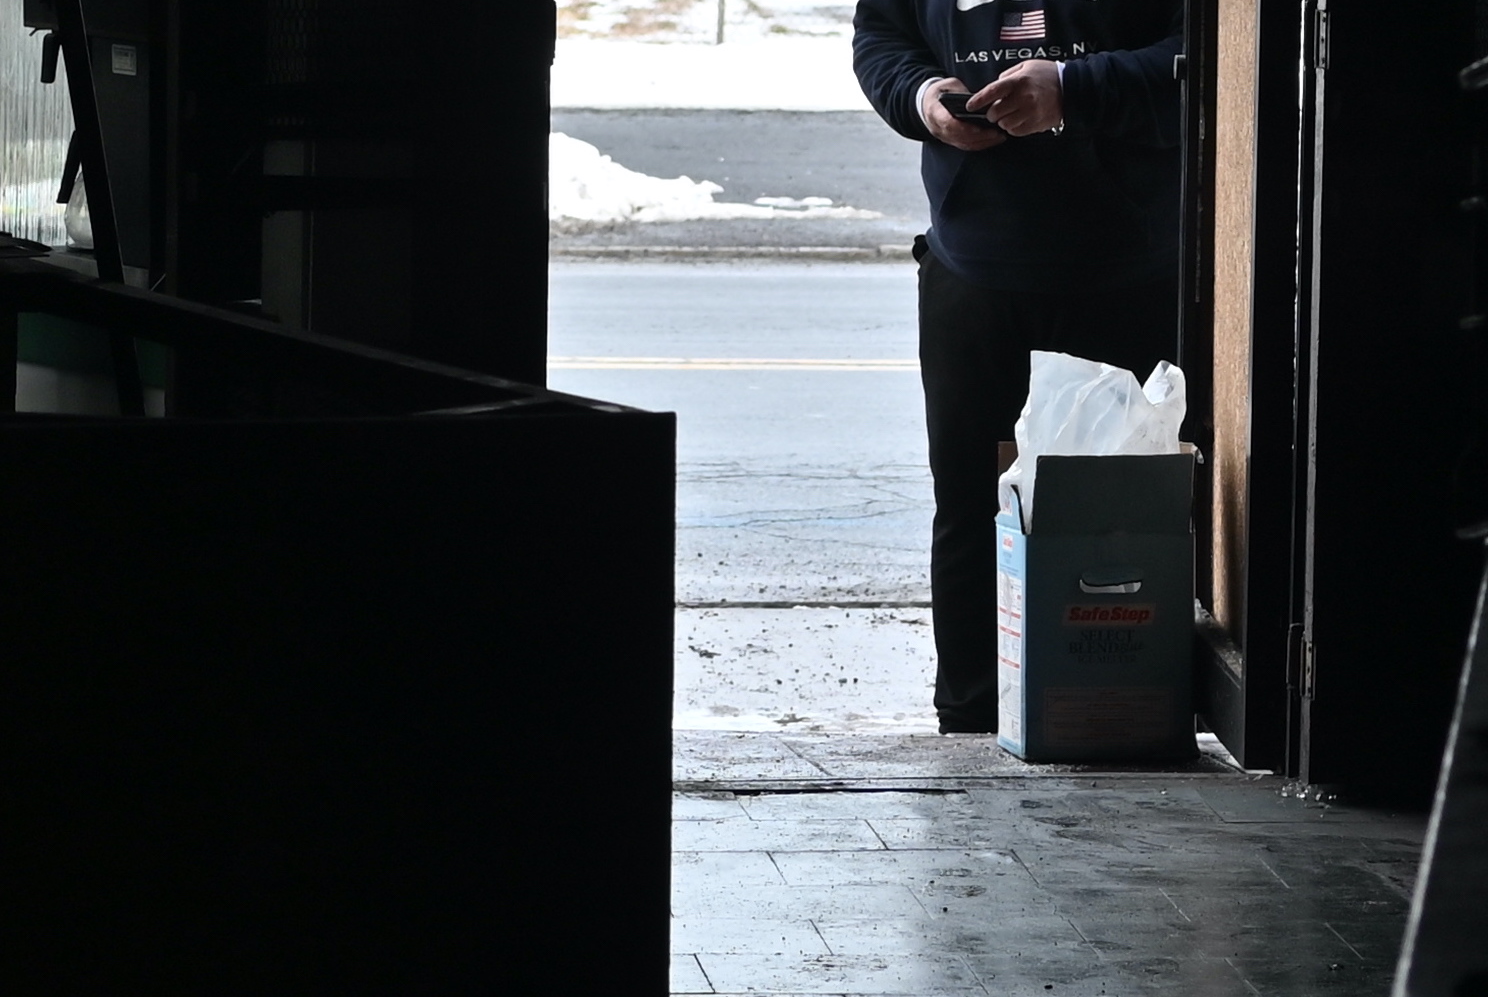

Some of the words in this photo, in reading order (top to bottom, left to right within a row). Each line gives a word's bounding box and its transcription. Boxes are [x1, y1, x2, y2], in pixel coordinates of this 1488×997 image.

[954, 51, 989, 64] LAS
[991, 44, 1068, 62] VEGAS,
[1068, 606, 1150, 624] SafeStep
